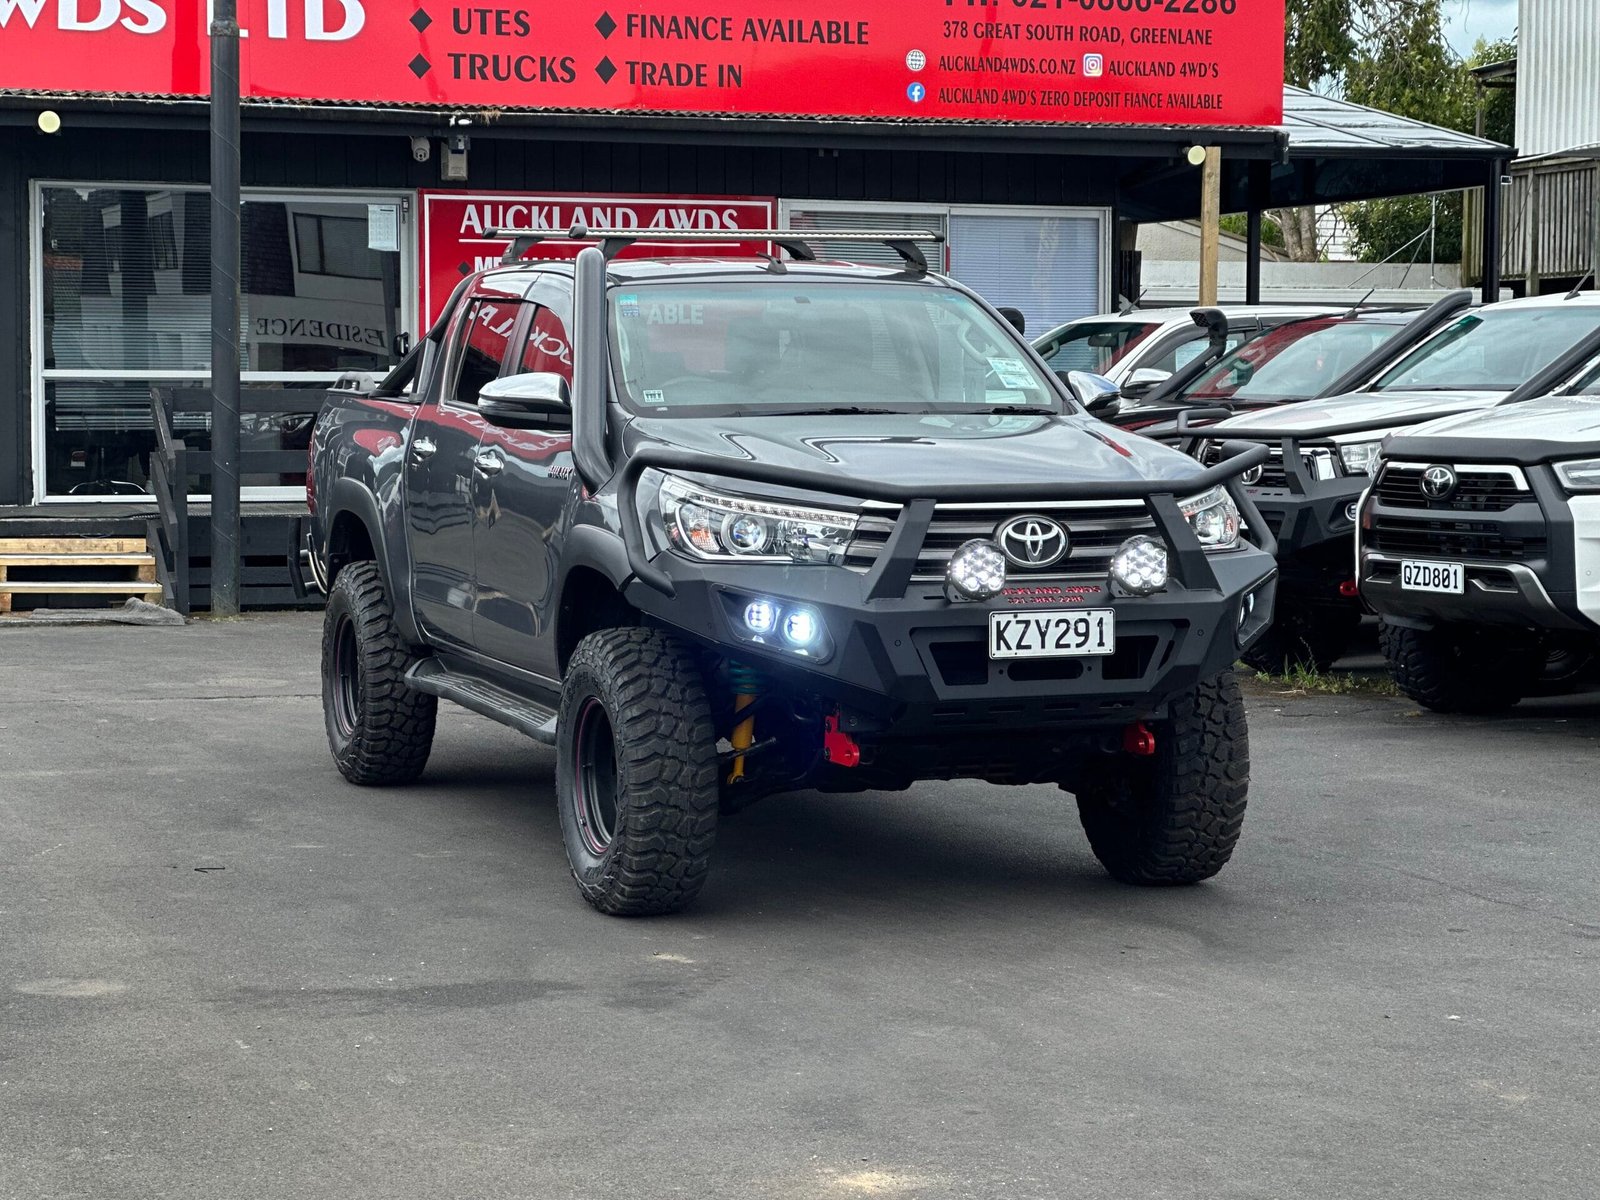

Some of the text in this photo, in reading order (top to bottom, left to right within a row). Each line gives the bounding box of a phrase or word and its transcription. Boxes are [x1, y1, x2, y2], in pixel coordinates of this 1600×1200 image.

[452, 7, 531, 38] UTES
[626, 13, 869, 45] FINANCE AVAILABLE
[943, 21, 1213, 46] 378 GREAT SOUTH ROAD, GREENLANE
[447, 52, 577, 84] TRUCKS
[625, 60, 742, 88] TRADE IN
[938, 55, 1076, 75] AUCKLAND4WDS.CO.NZ
[1108, 60, 1219, 79] AUCKLAND 4WD'S
[938, 87, 1223, 110] AUCKLAND 4WD'S ZERO DEPOSIT FIANCE AVAILABLE
[459, 203, 739, 235] AUCKLAND 4WDS
[1403, 564, 1459, 590] QZD801
[995, 616, 1106, 652] KZY291
